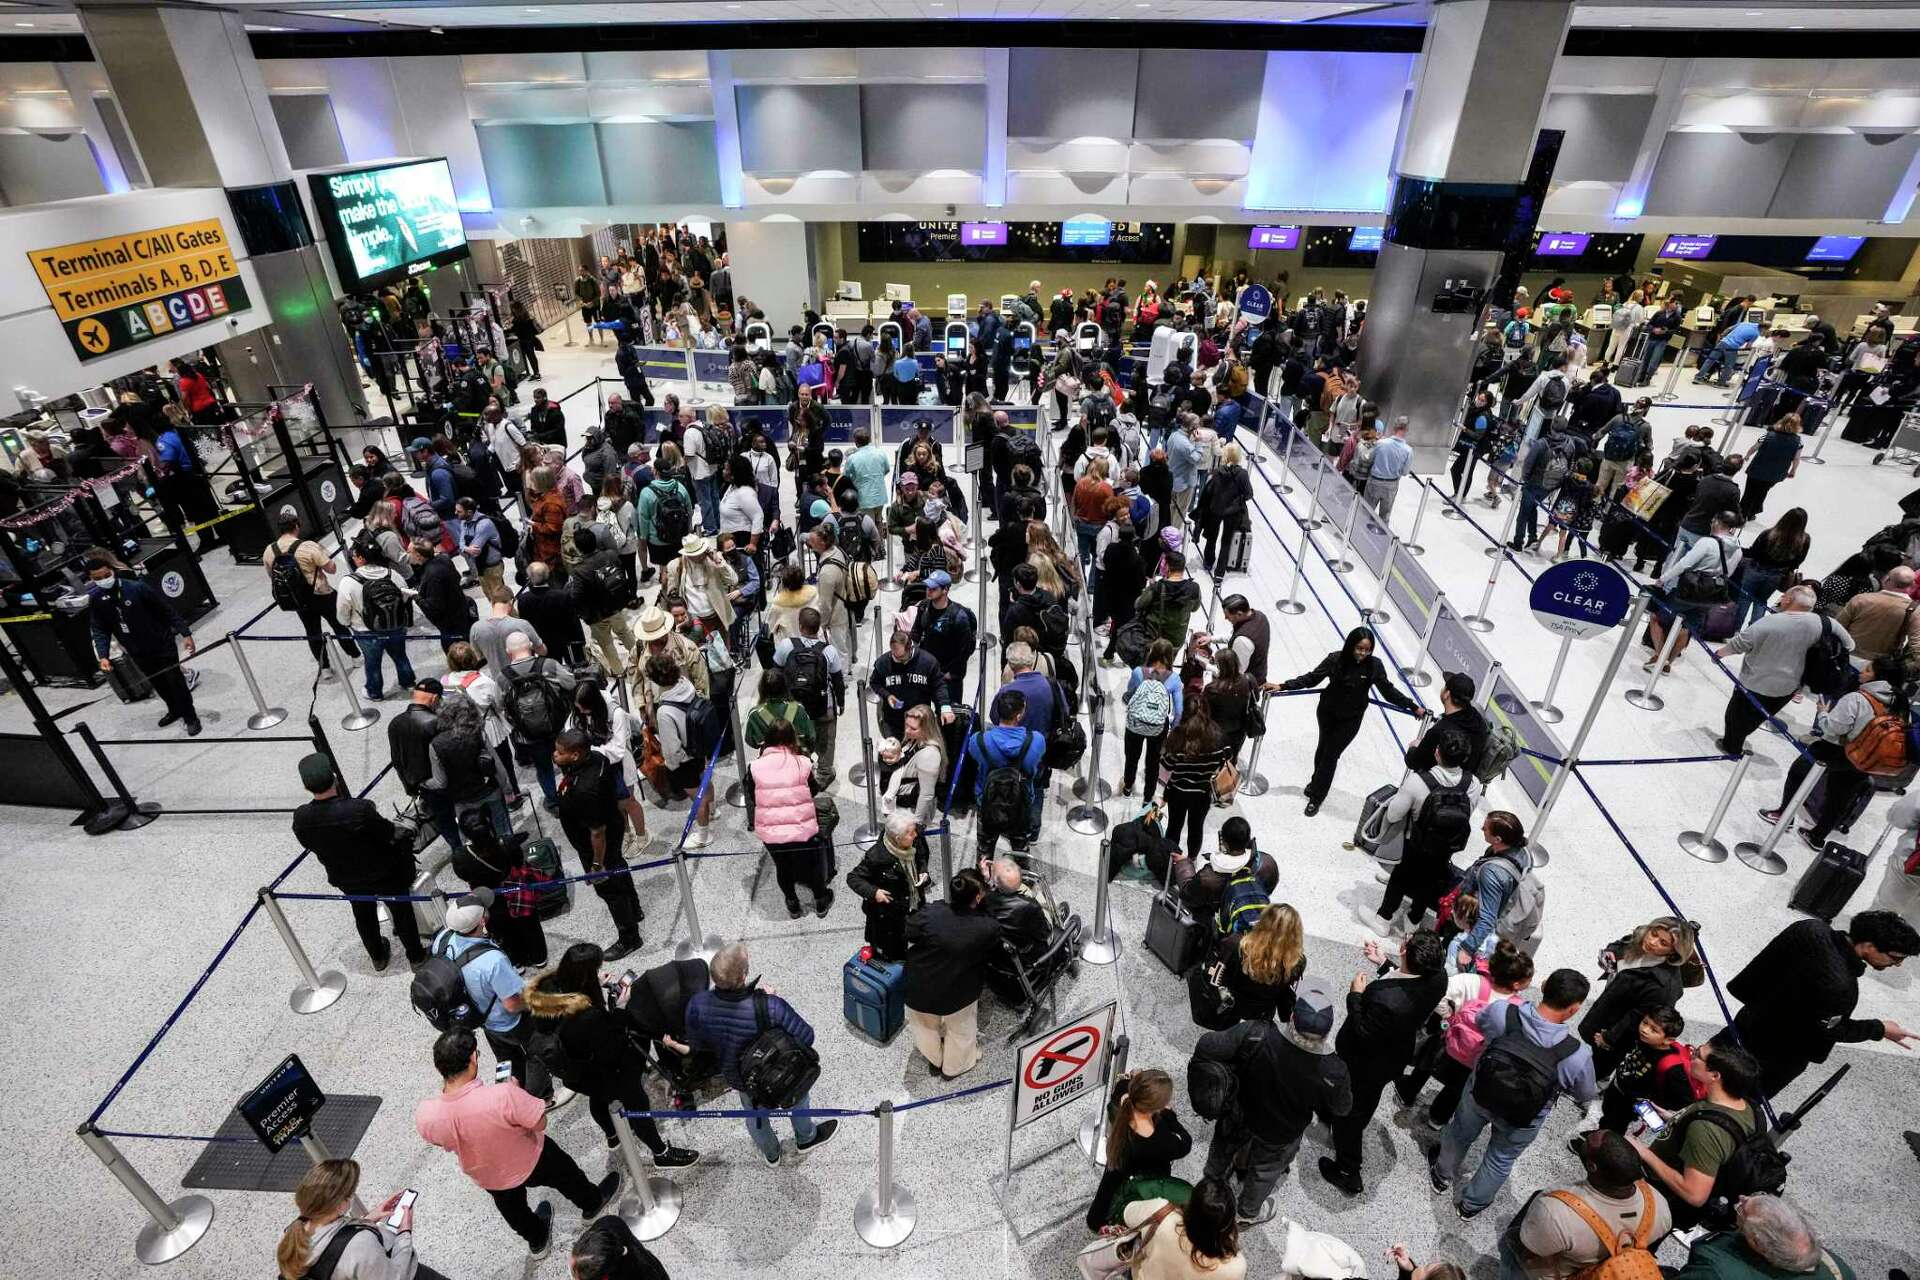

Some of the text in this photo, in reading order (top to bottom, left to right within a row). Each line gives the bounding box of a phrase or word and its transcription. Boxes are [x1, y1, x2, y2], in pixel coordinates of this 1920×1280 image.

[329, 173, 376, 198] Simply
[339, 201, 377, 224] make
[376, 197, 398, 216] the
[930, 232, 958, 241] Premier
[41, 228, 221, 278] Terminal C/All Gates
[58, 255, 230, 312] Terminals A, B, D, E
[1553, 591, 1605, 610] CLEAR
[1550, 622, 1564, 630] TSA
[885, 673, 928, 686] NEW YORK
[260, 1069, 286, 1094] UNITED
[1034, 1074, 1084, 1104] NO GUNS
[260, 1088, 298, 1128] Premier
[1032, 1081, 1084, 1113] ALLOWED
[266, 1101, 297, 1136] Access
